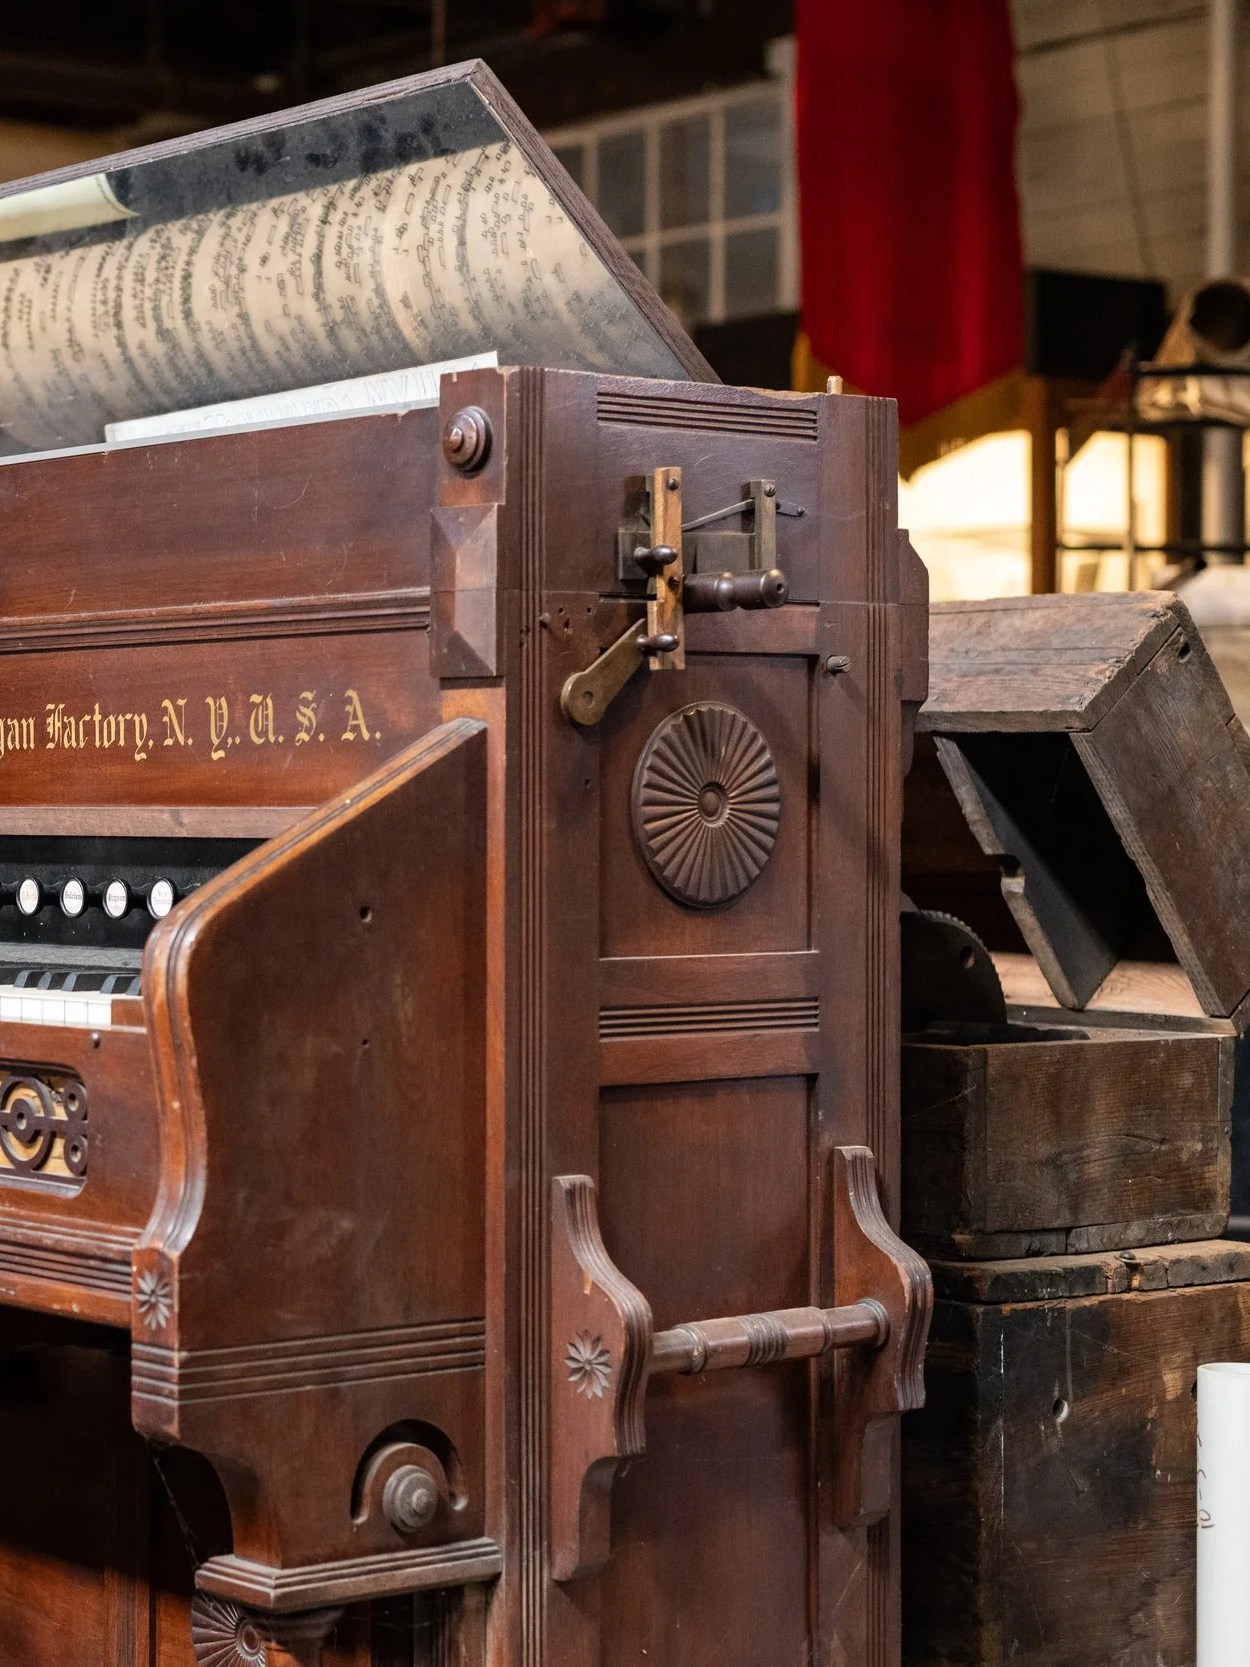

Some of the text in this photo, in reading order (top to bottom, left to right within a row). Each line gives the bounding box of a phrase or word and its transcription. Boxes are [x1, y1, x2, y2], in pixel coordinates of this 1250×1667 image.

[45, 702, 154, 761] Factory,
[161, 698, 194, 746] N.
[295, 689, 325, 746] S.
[340, 689, 382, 743] A.
